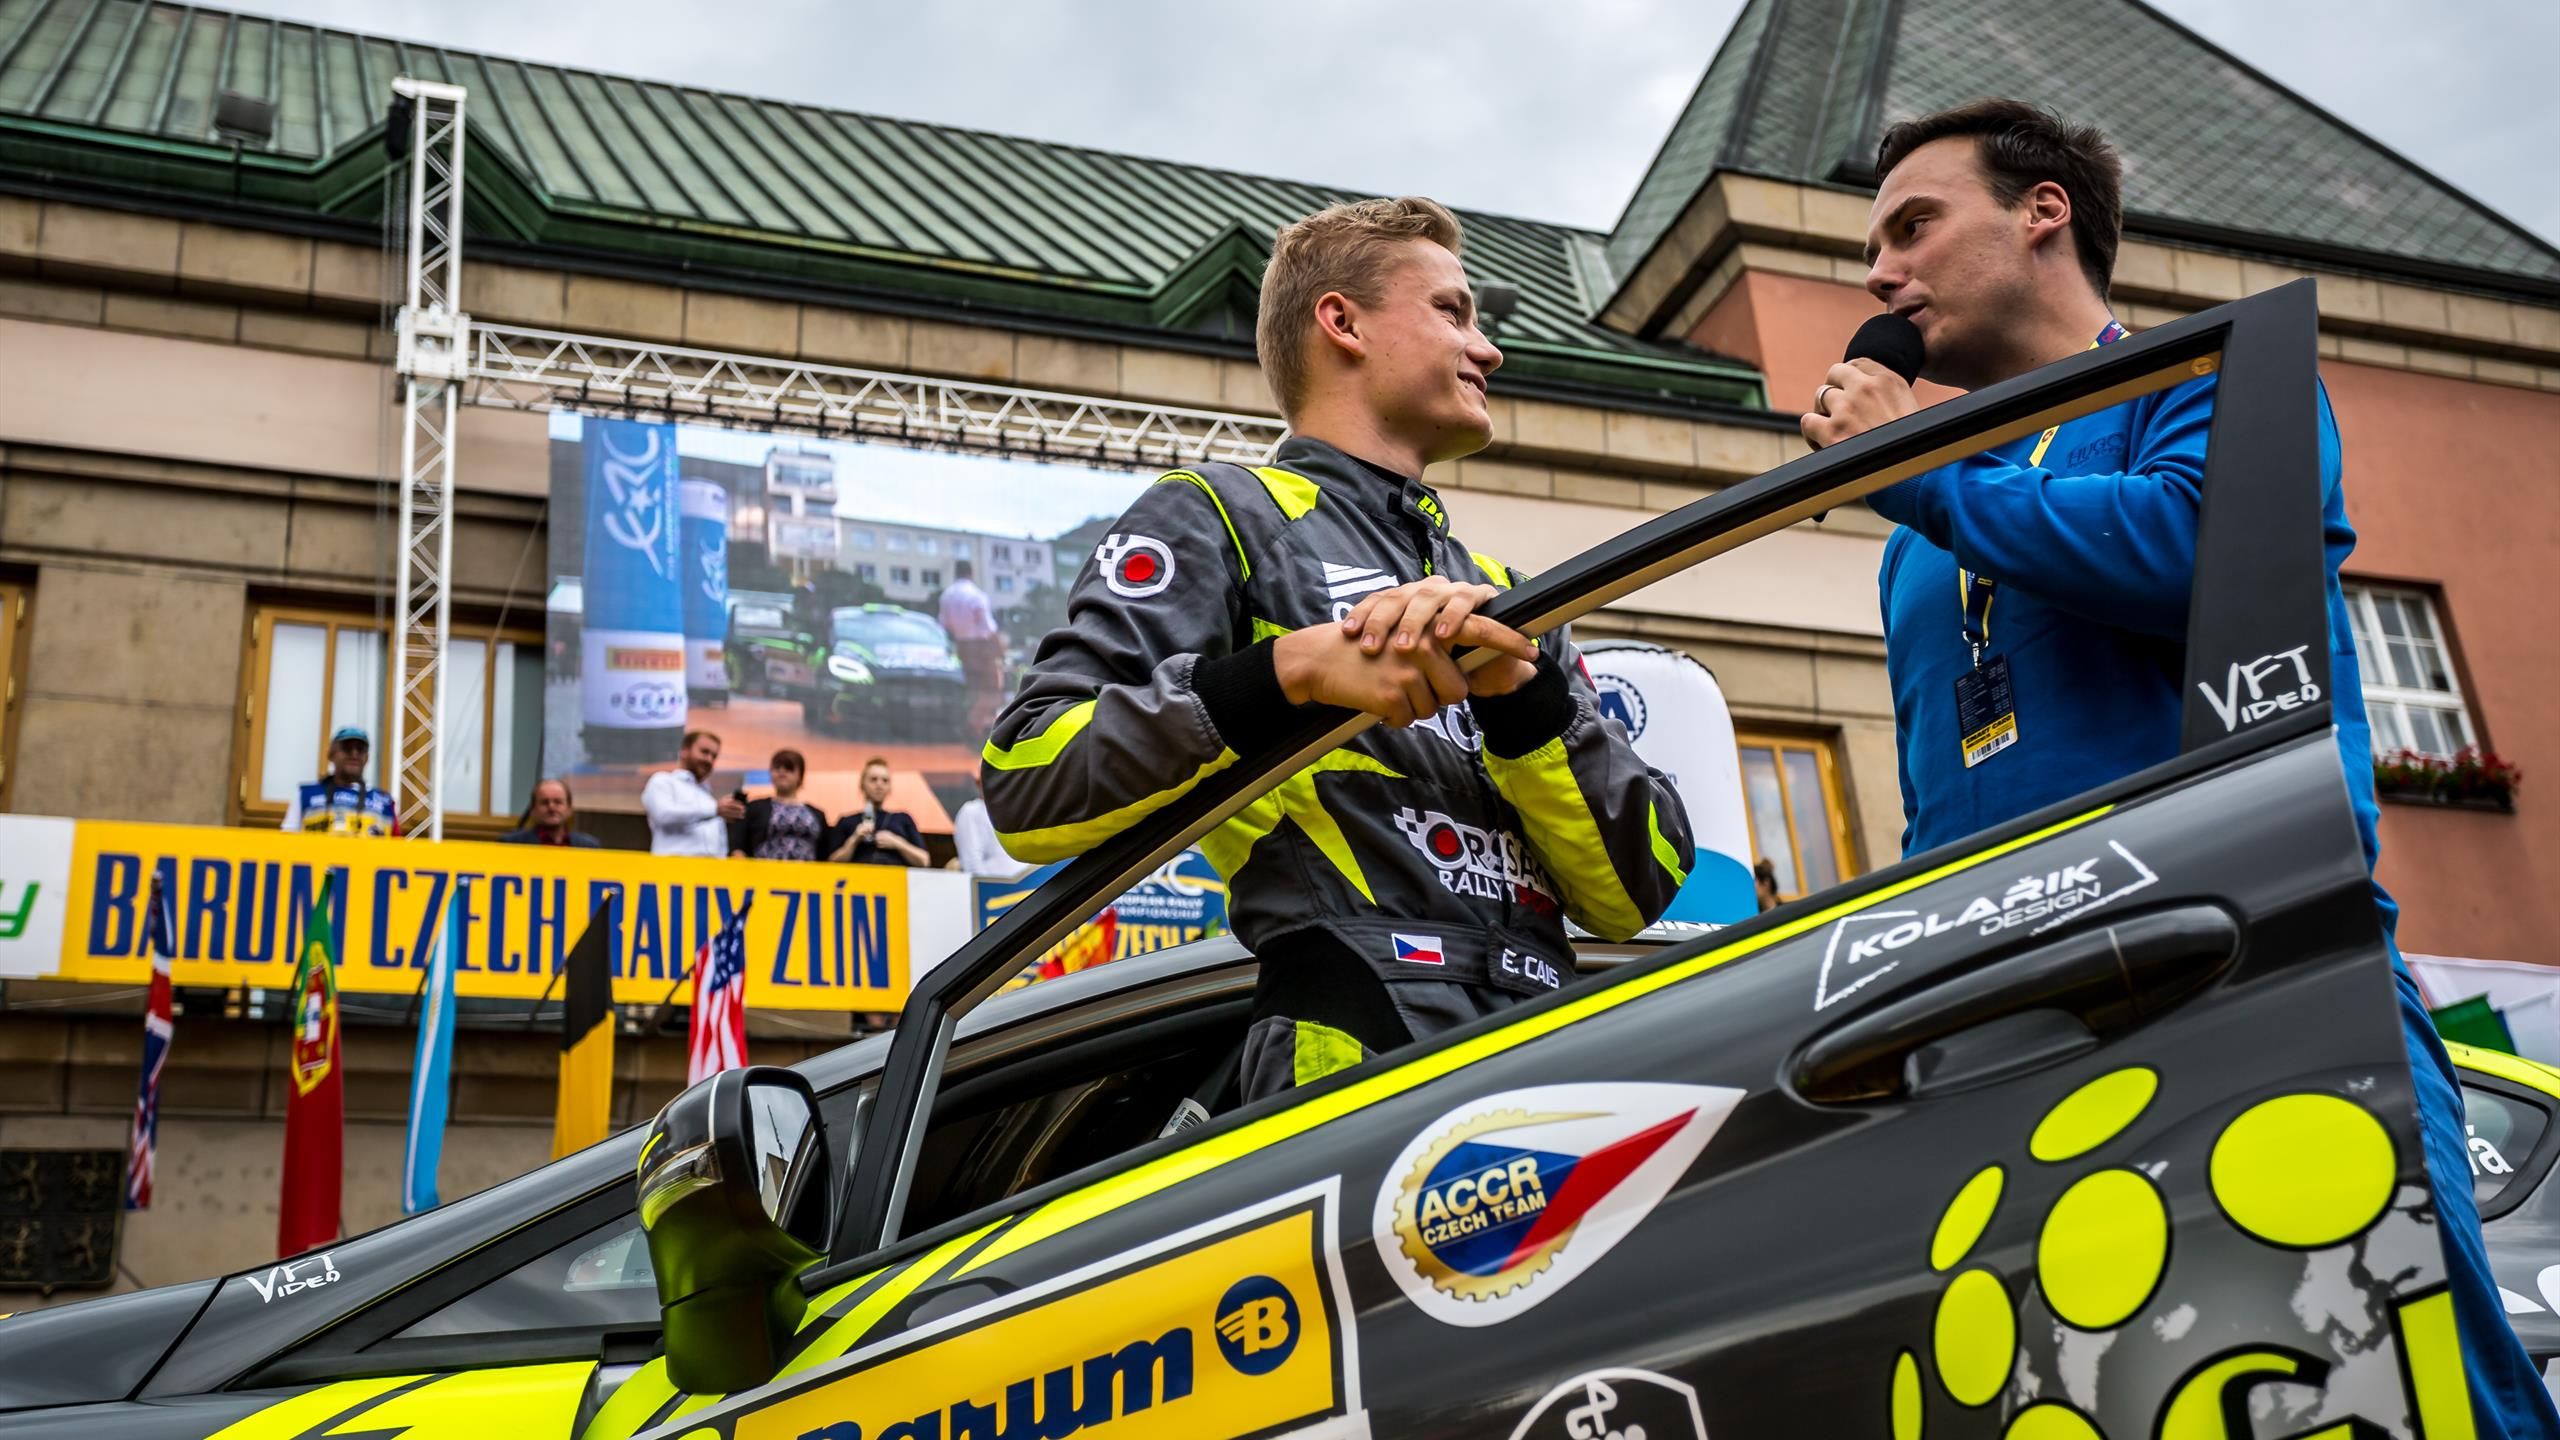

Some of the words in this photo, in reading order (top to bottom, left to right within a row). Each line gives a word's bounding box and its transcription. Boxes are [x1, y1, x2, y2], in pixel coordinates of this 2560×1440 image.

[2065, 432, 2125, 466] HUGO
[87, 853, 350, 966] BARUM
[370, 868, 567, 976] CZECH
[769, 879, 890, 989] ZLÍN
[1979, 881, 2101, 937] DESIGN
[1502, 947, 1520, 974] E.
[1524, 955, 1560, 989] CAIS
[1420, 1156, 1543, 1229] ACCR
[1422, 1210, 1489, 1246] CZECH
[1490, 1190, 1548, 1223] TEAM
[797, 1326, 1194, 1440] rum
